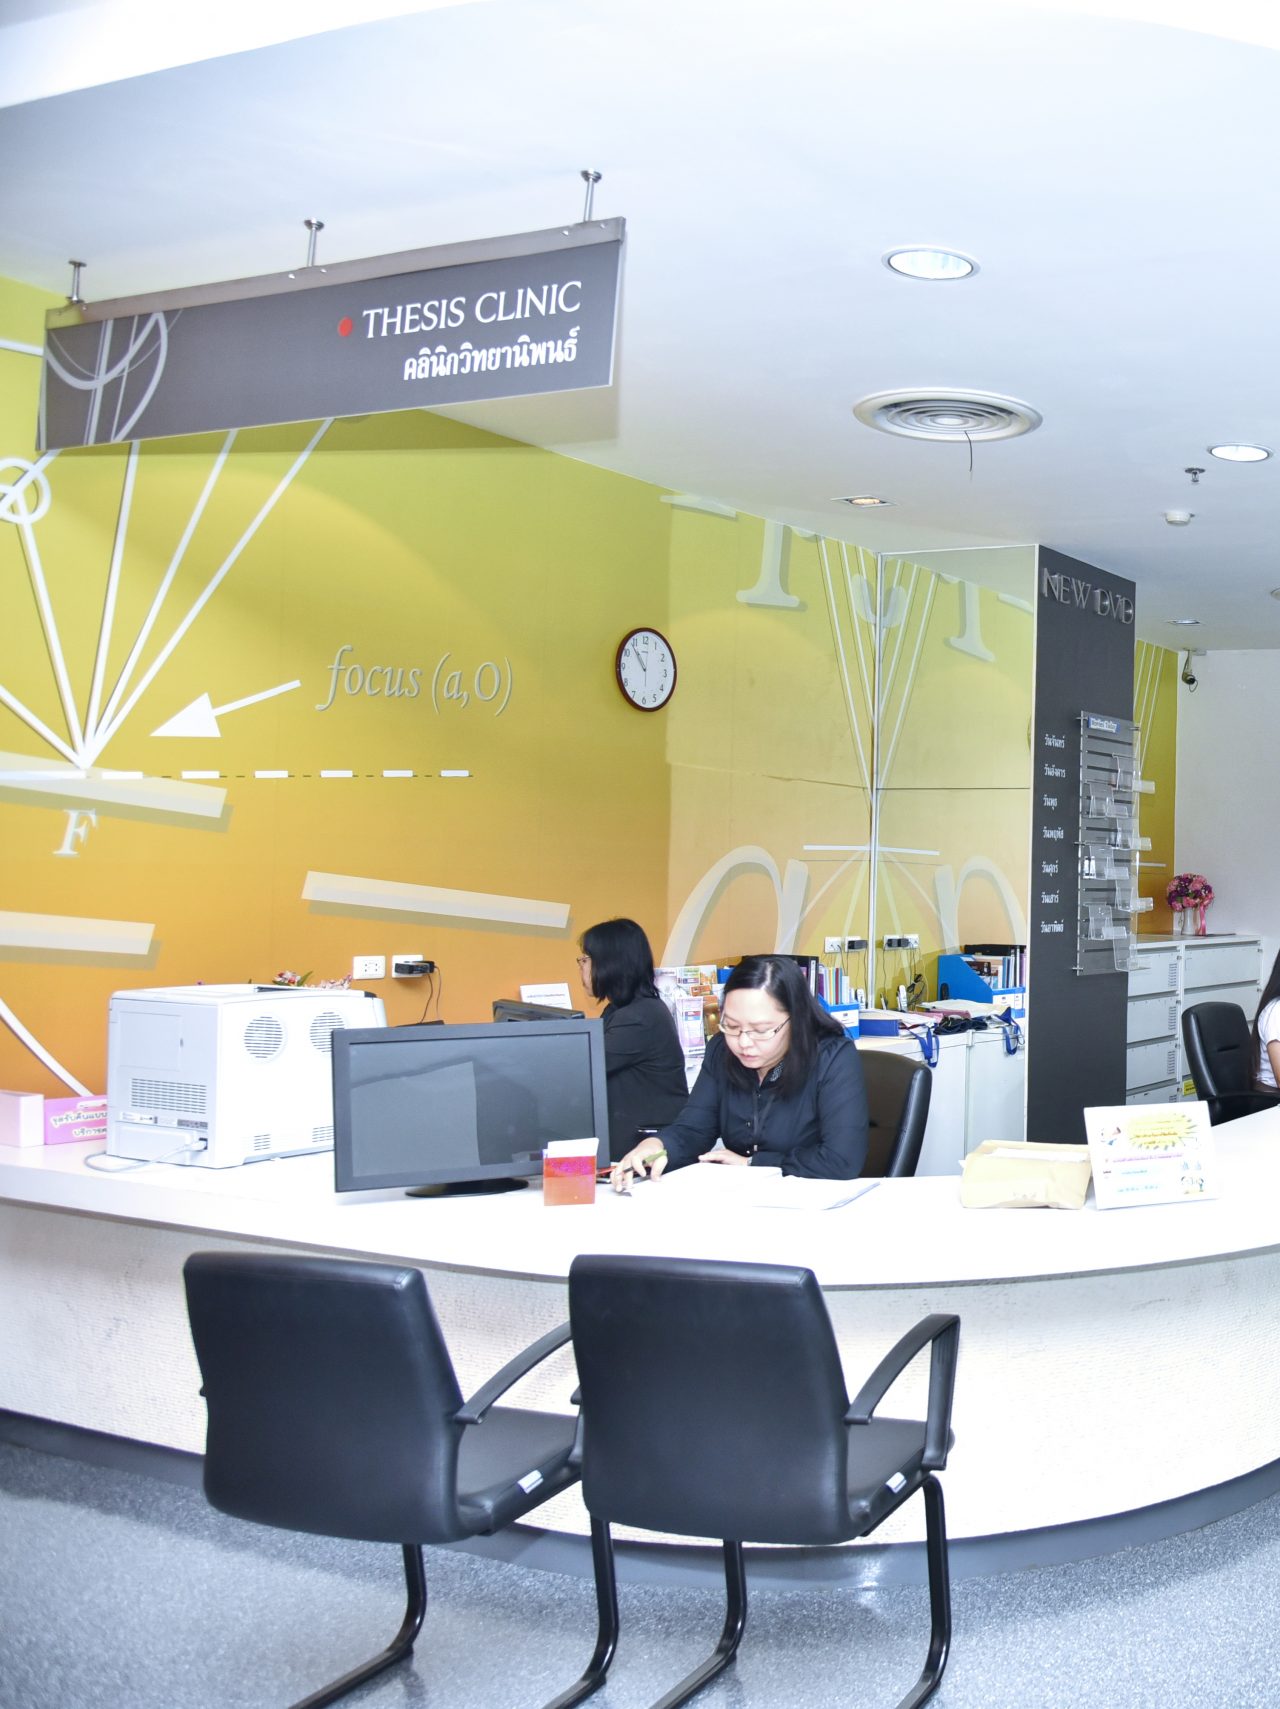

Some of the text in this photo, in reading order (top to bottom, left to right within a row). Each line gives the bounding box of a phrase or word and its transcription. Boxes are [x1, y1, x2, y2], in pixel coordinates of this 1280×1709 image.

[362, 280, 582, 339] THESIS CLINIC
[403, 326, 581, 381] คลินิกวิทยานิพนธ์
[1042, 567, 1134, 625] NEW DVD
[314, 644, 423, 711] focus
[52, 808, 98, 858] F
